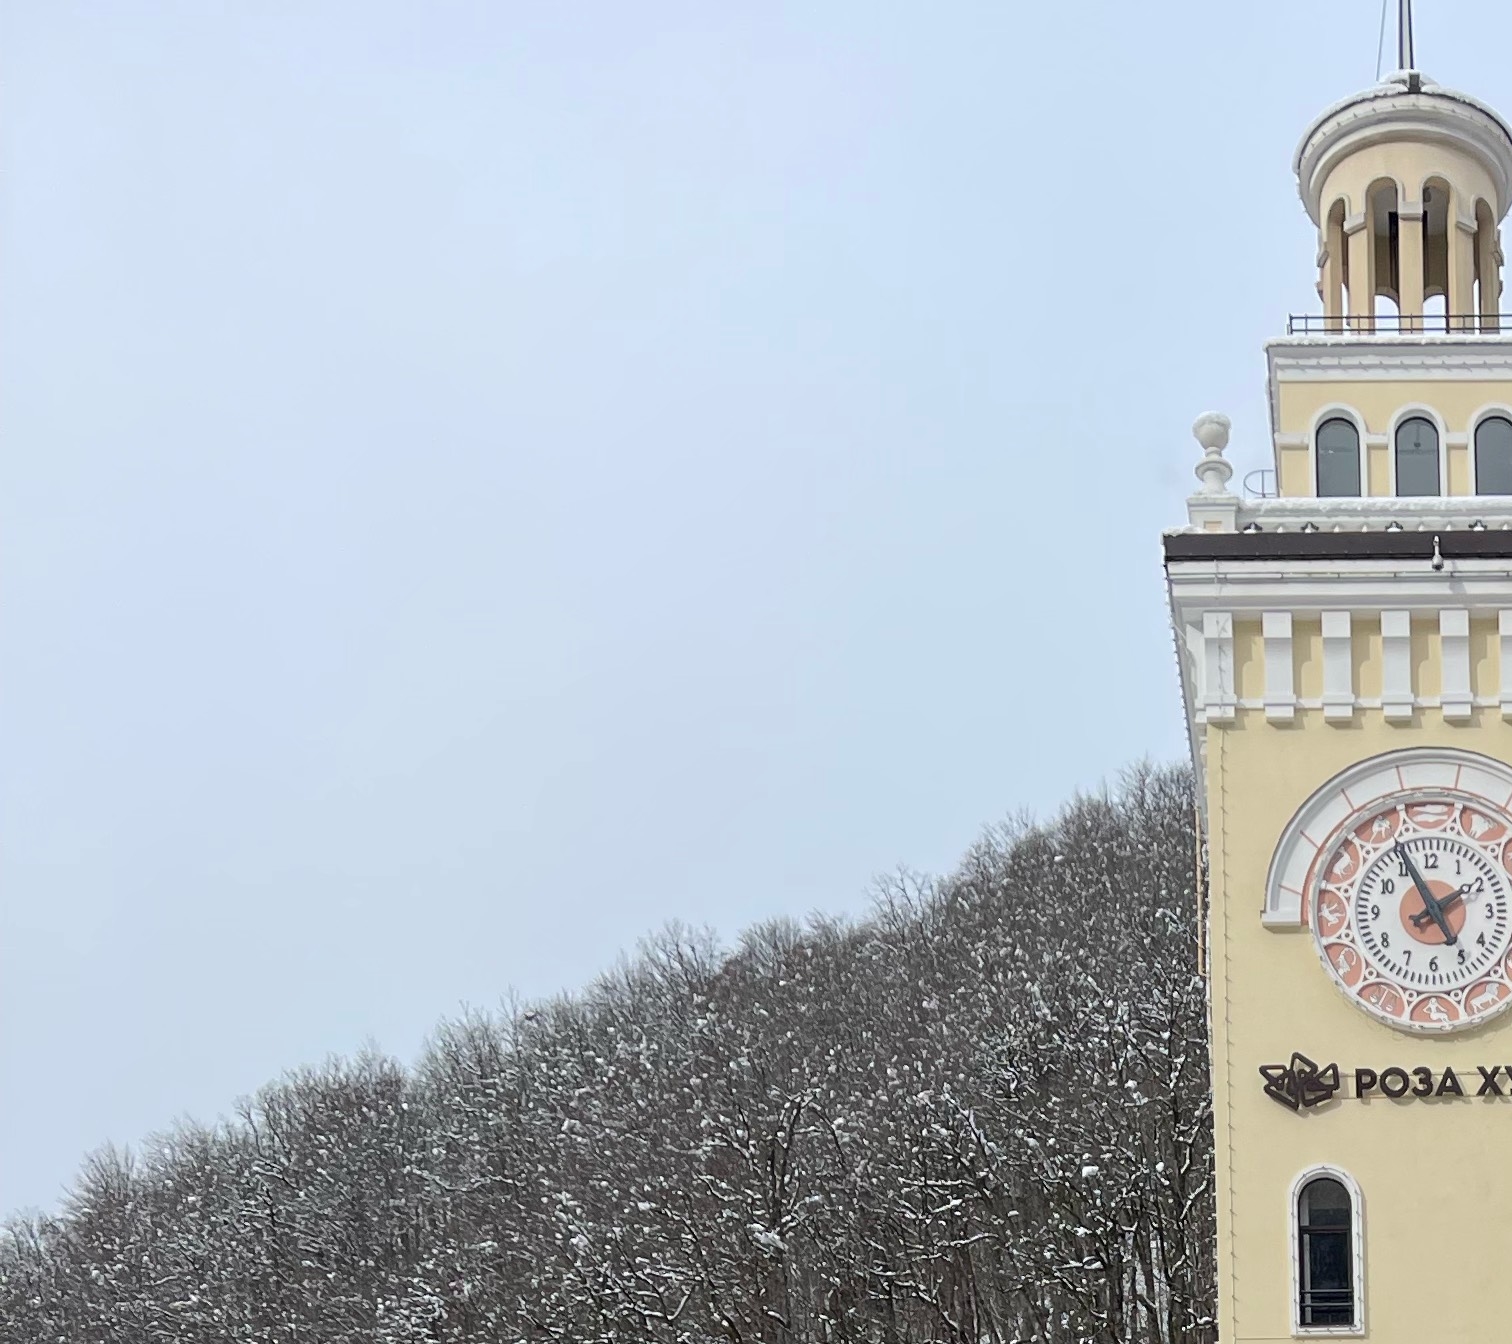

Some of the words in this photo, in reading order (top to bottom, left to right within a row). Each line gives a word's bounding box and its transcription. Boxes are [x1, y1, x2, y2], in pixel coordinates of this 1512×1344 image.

[1398, 861, 1410, 877] 11
[1424, 853, 1438, 869] 12
[1380, 878, 1395, 895] 10
[1475, 876, 1484, 893] 2
[1371, 905, 1380, 920] 9
[1485, 903, 1494, 919] 3
[1381, 932, 1389, 948] 8
[1476, 932, 1486, 947] 4
[1403, 950, 1412, 966] 7
[1429, 956, 1438, 972] 6
[1457, 949, 1466, 966] 5
[1355, 1066, 1464, 1098] РОЗА
